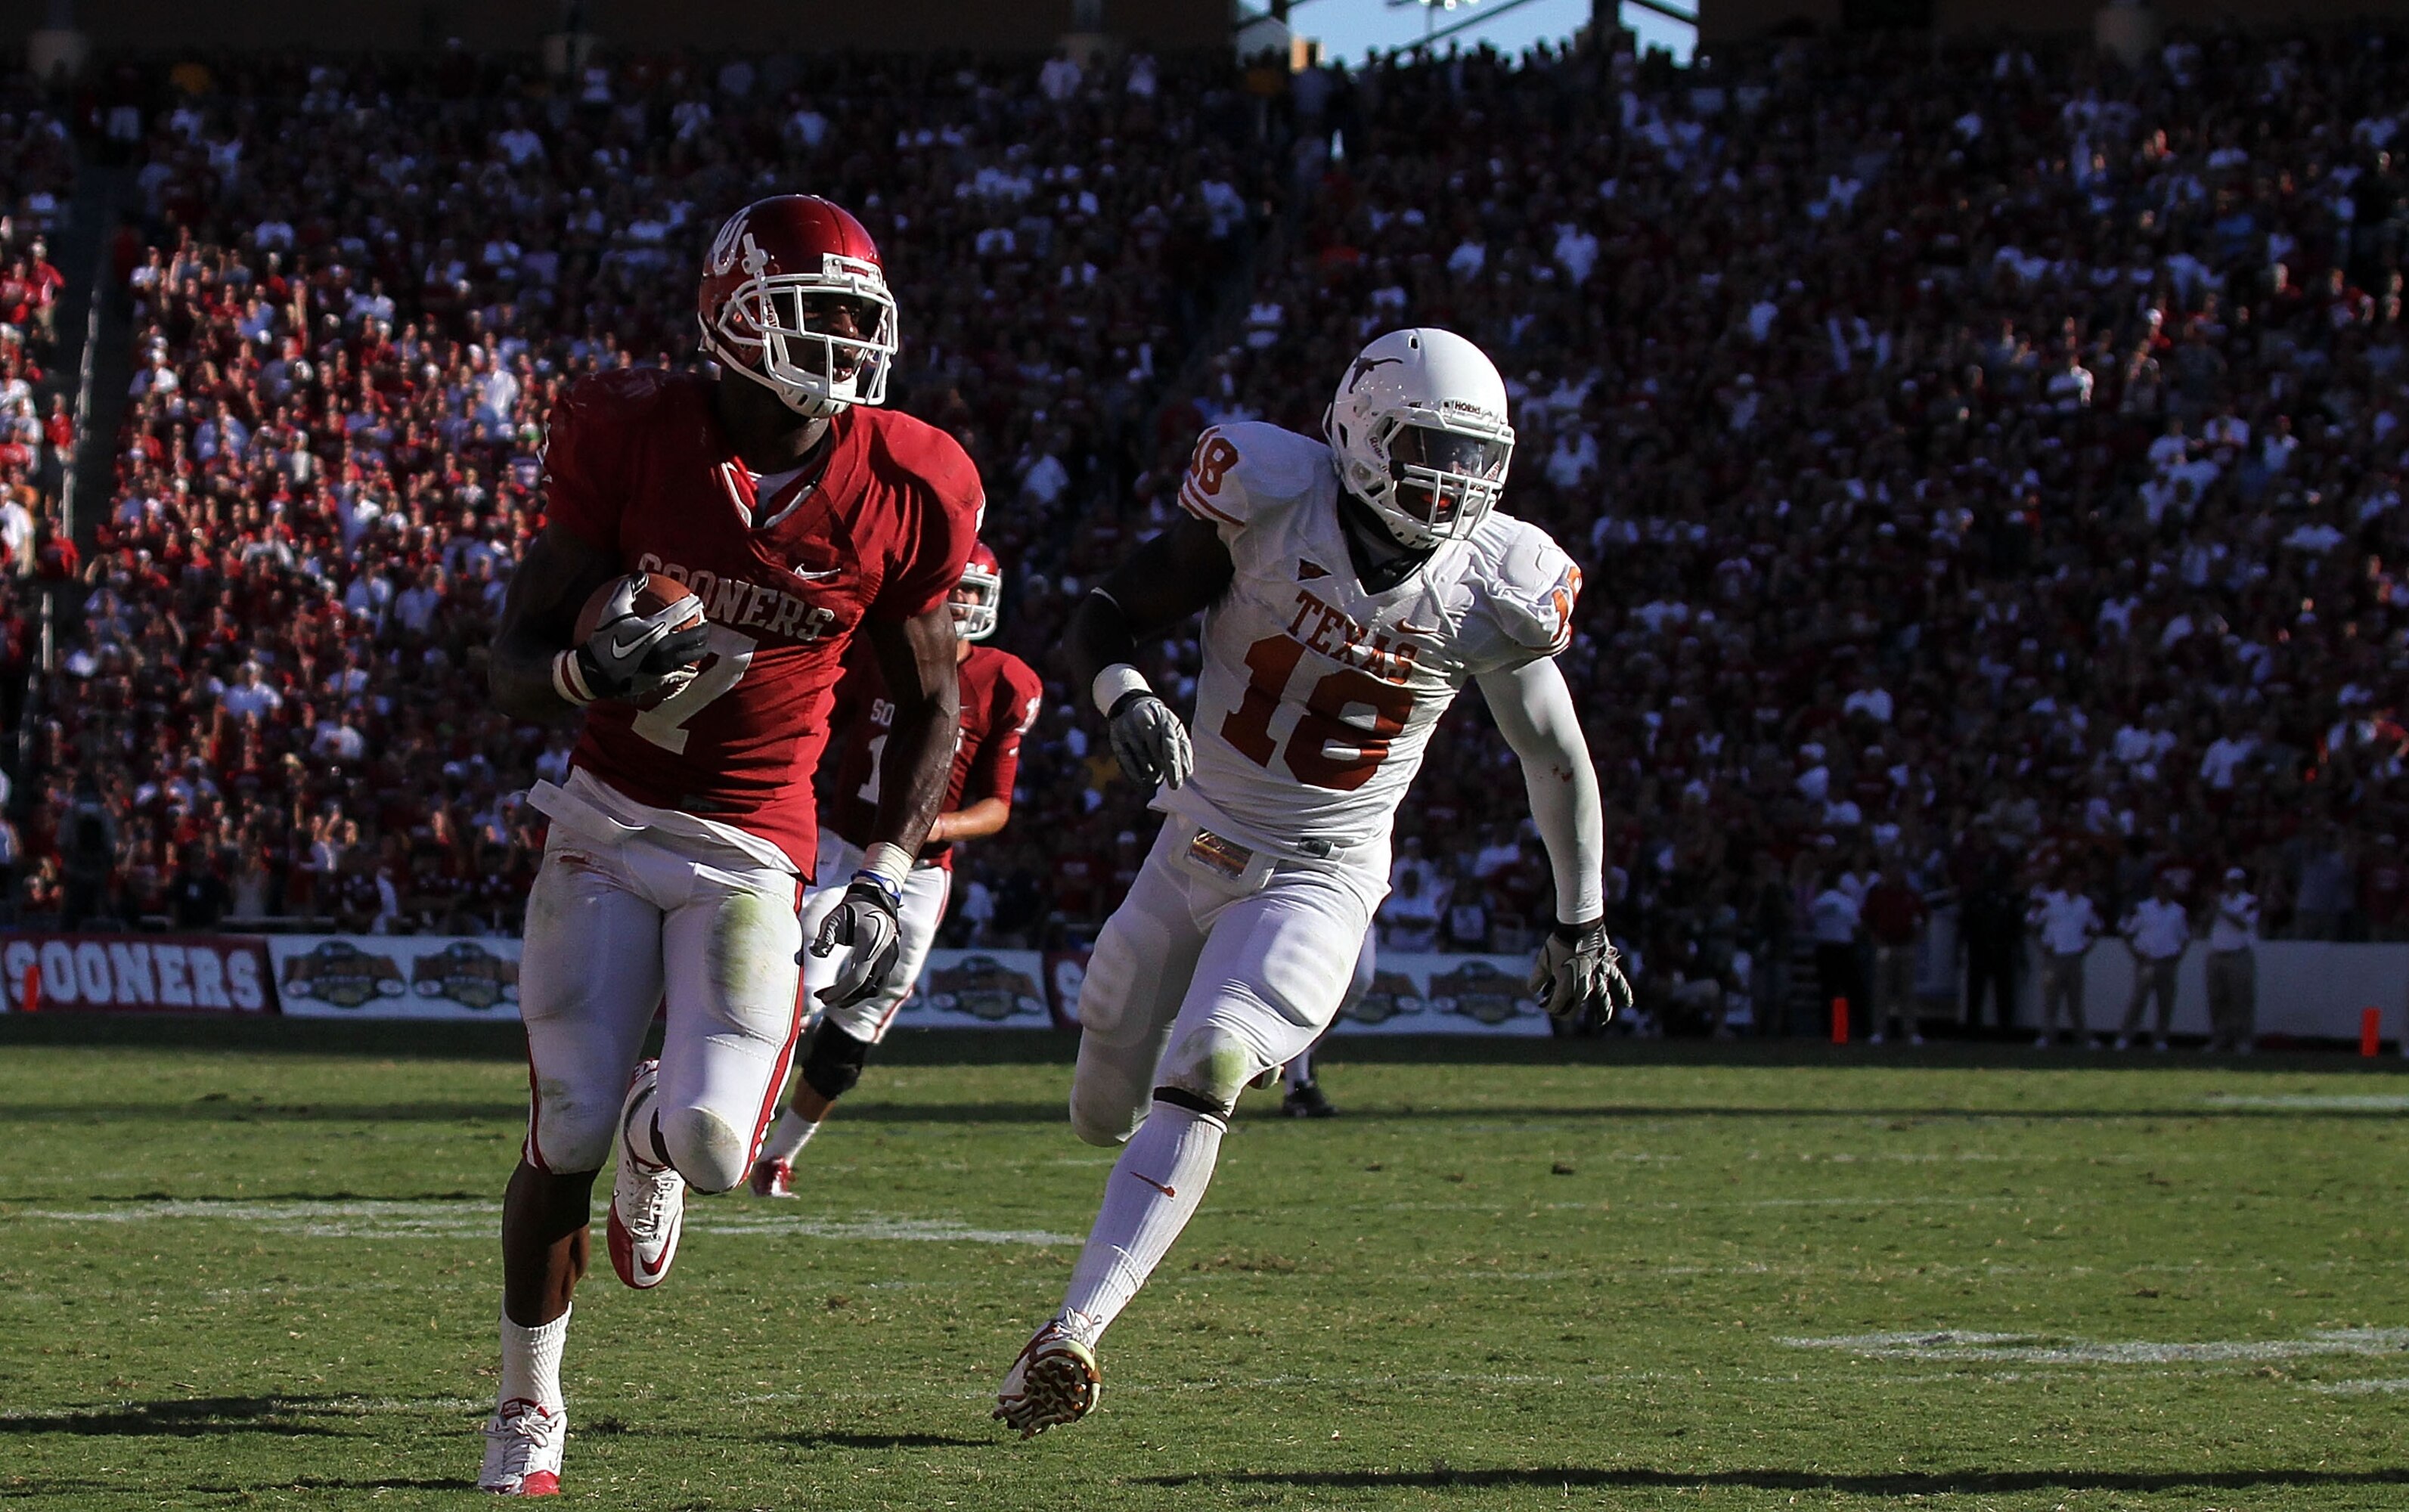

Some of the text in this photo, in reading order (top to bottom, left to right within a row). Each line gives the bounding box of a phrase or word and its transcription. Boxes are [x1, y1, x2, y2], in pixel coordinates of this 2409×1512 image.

[631, 620, 758, 755] 7
[1287, 590, 1419, 685] TEXAS
[1220, 632, 1414, 791] 18
[5, 940, 263, 1010] SOONERS
